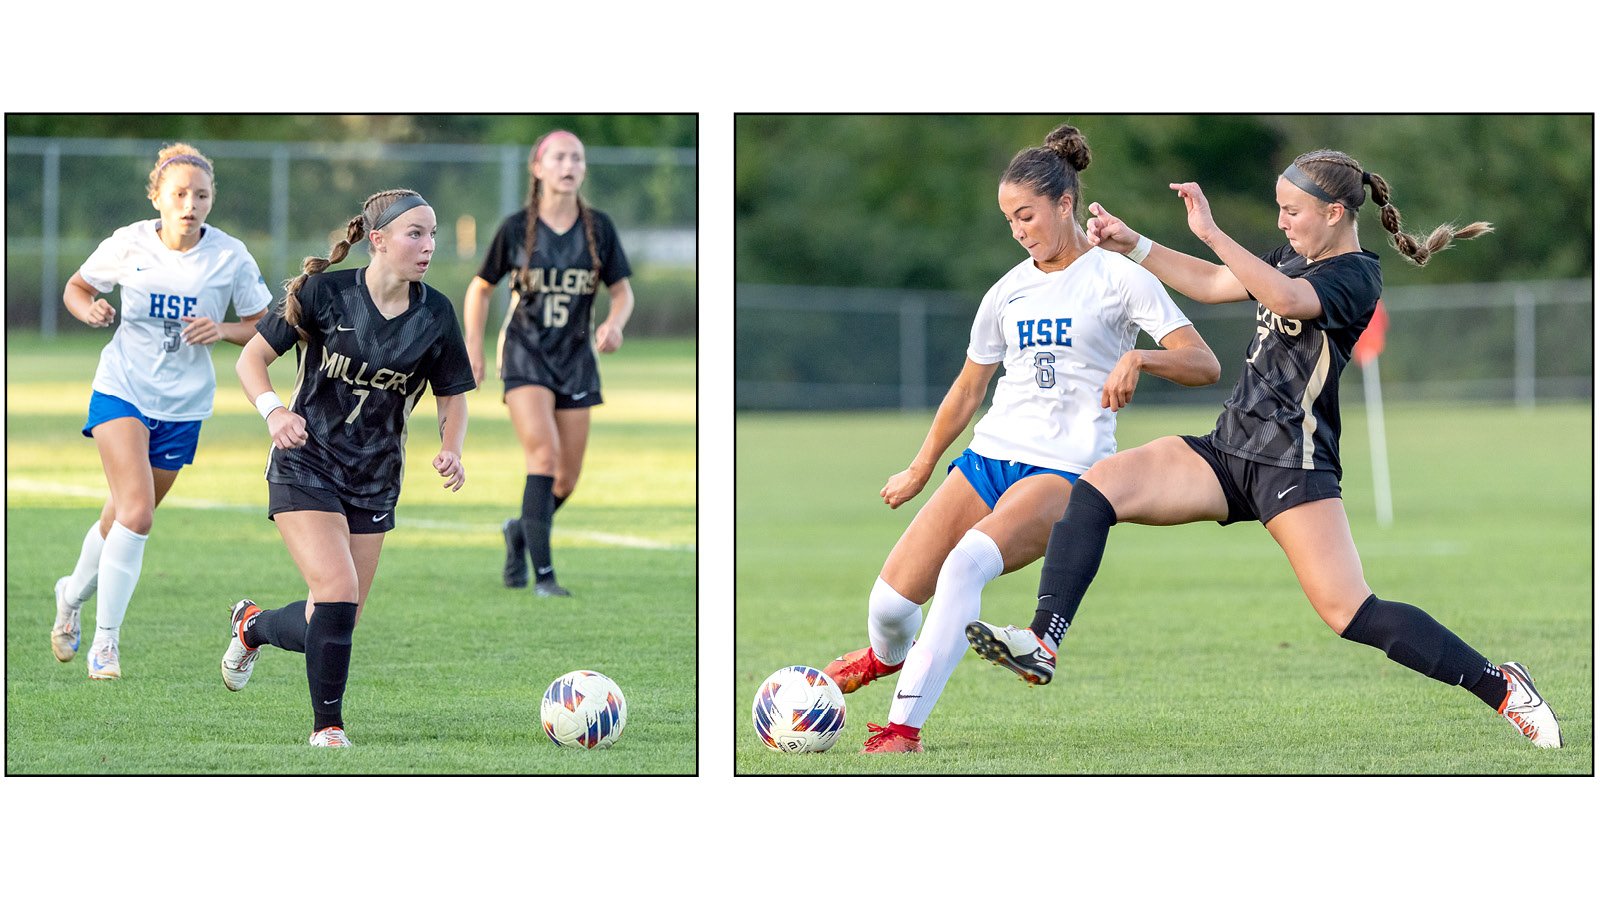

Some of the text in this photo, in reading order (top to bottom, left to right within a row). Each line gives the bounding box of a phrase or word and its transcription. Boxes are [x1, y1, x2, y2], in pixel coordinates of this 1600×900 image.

[149, 293, 197, 320] HSE
[543, 294, 571, 328] 15
[163, 320, 182, 353] 5
[1017, 318, 1072, 350] HSE
[319, 345, 414, 395] MILLERS
[1033, 351, 1056, 389] 6
[345, 389, 370, 424] 7
